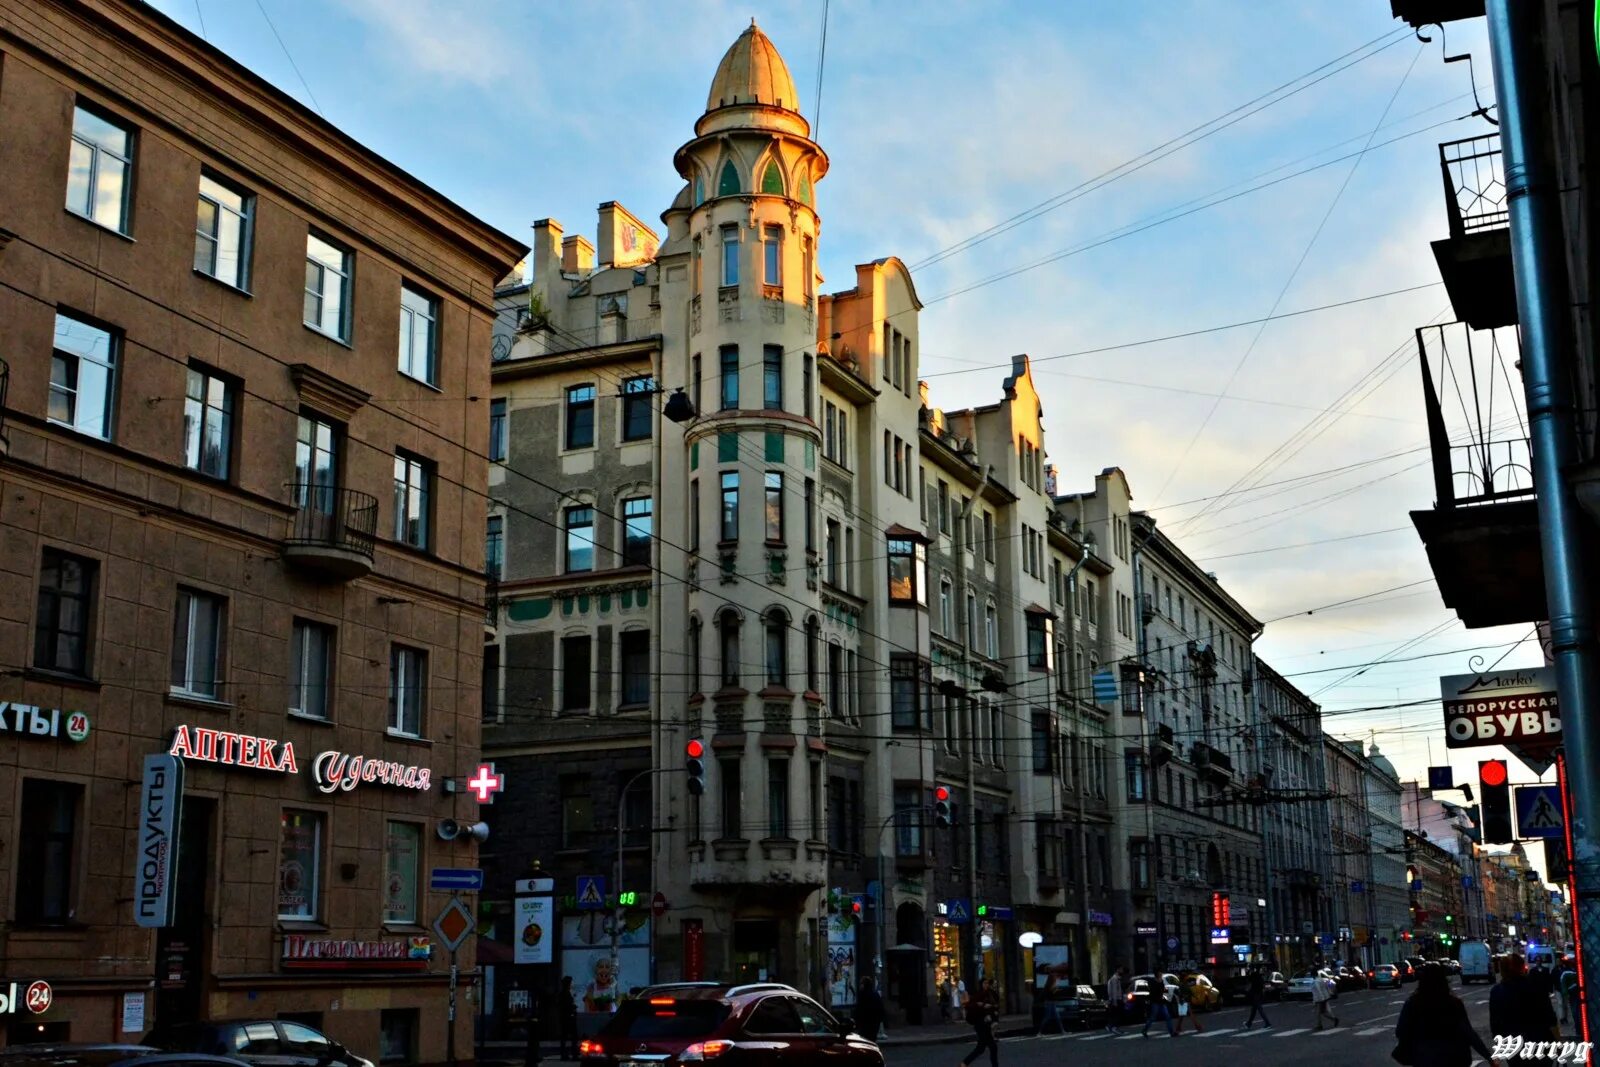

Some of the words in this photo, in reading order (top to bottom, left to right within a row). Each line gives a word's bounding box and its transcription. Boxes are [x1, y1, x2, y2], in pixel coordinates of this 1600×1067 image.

[1458, 672, 1536, 695] Marko
[1448, 697, 1558, 714] БЕЛОРУССКАЯ
[71, 715, 86, 732] 24
[1448, 711, 1562, 741] ОБУВЬ
[170, 724, 299, 774] АПТЕКА
[312, 750, 432, 793] Удачная
[140, 766, 166, 918] ПРОДУКТЫ
[30, 988, 49, 1006] 24
